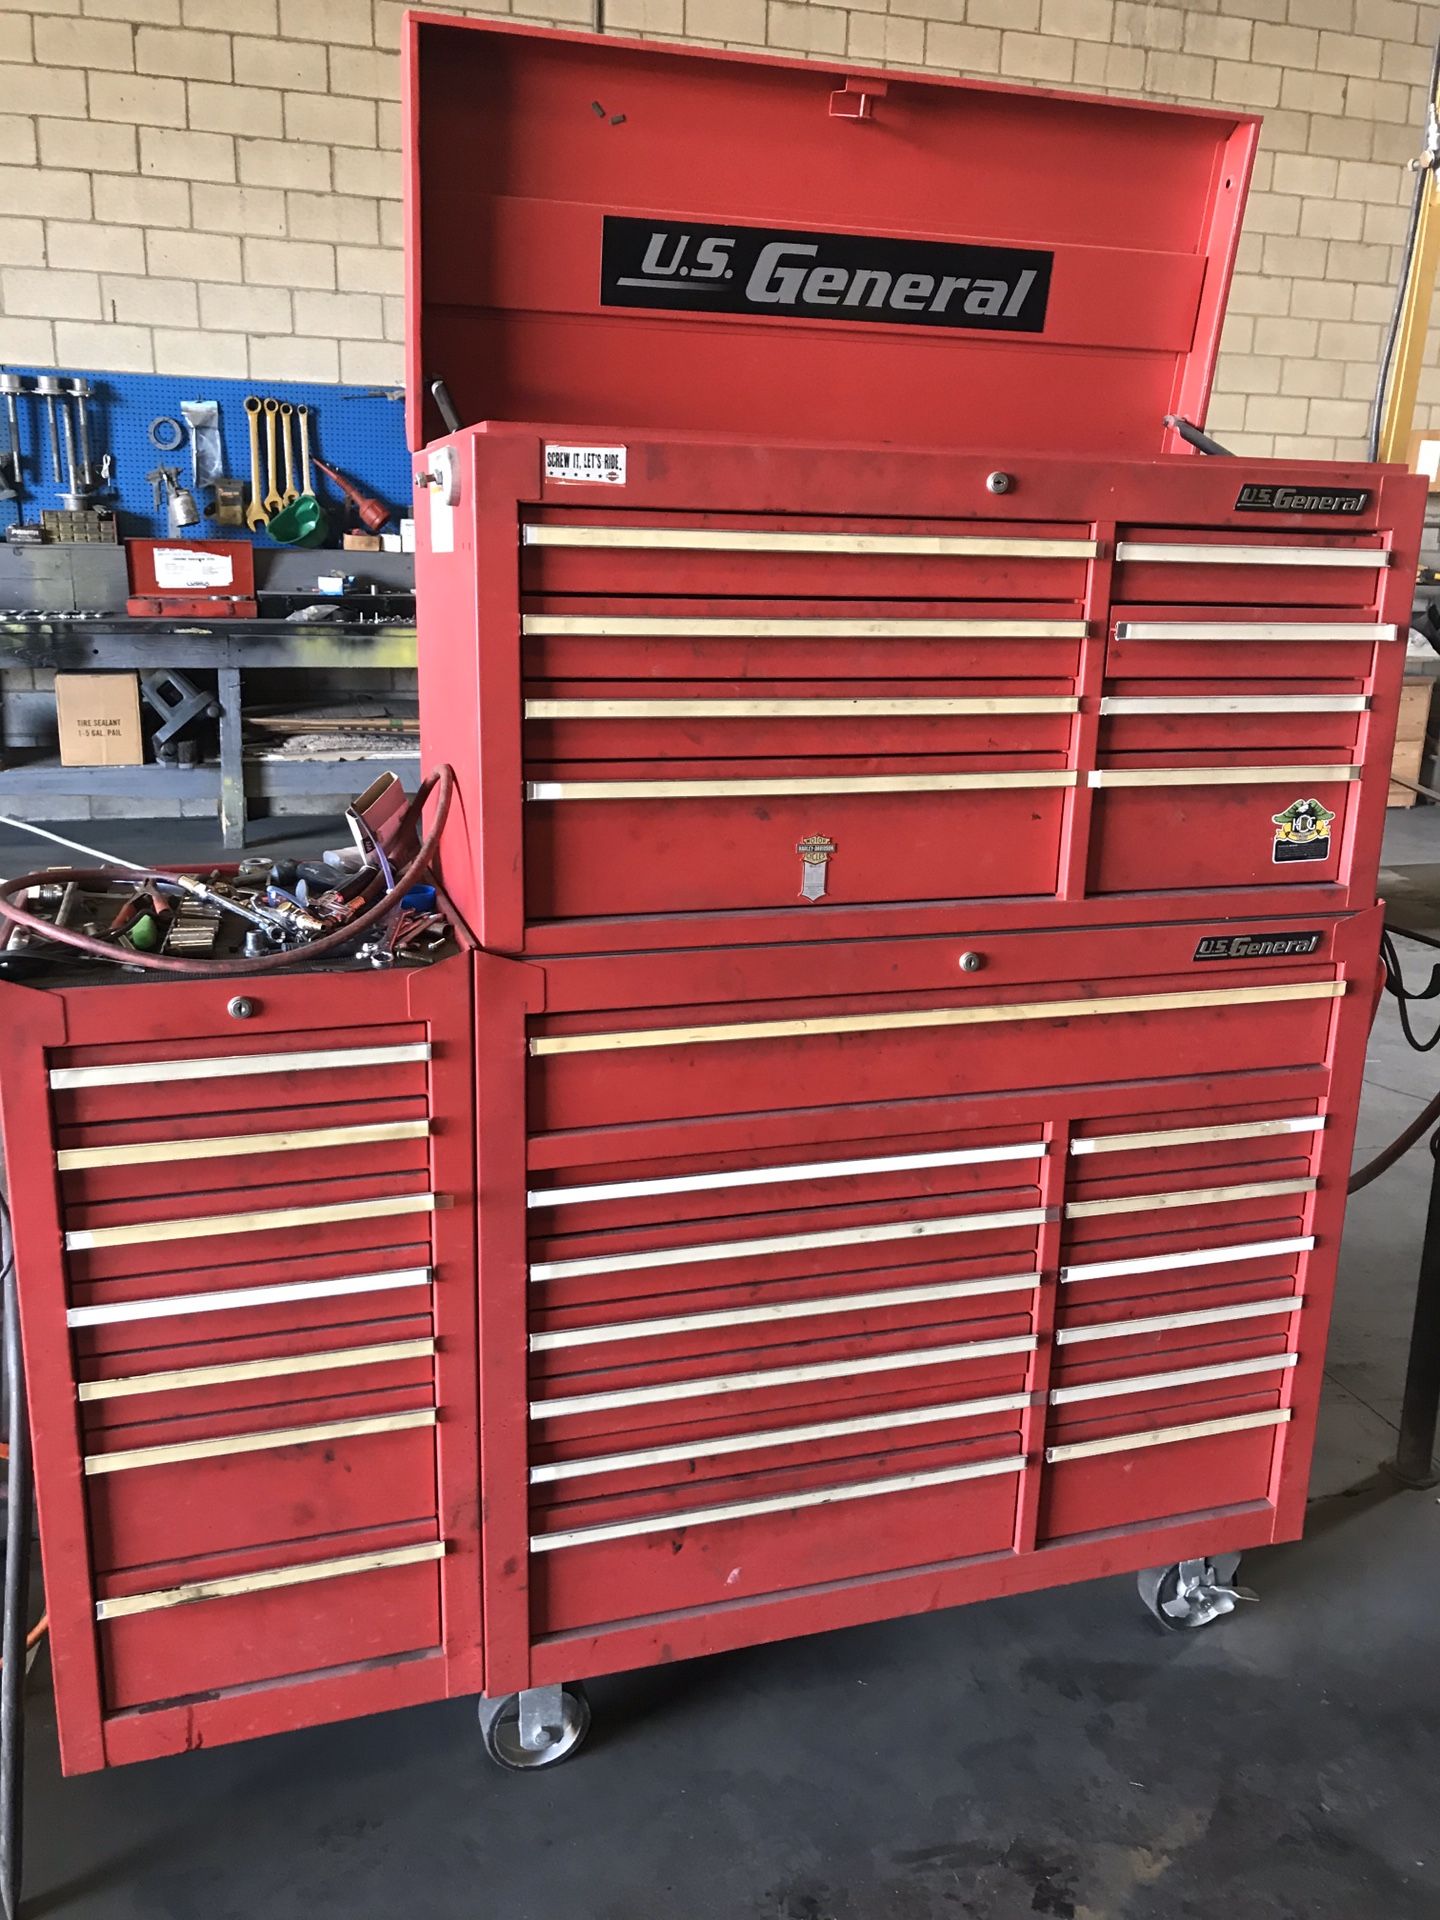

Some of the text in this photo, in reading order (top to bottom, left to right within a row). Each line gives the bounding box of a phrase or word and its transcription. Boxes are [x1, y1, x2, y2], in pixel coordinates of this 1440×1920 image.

[641, 232, 1038, 318] U.S. General
[547, 452, 570, 468] SCREW
[584, 453, 601, 469] LET'S
[1273, 488, 1367, 512] General
[93, 719, 121, 727] SEALANT
[107, 729, 122, 737] PAIL
[1229, 936, 1319, 957] General
